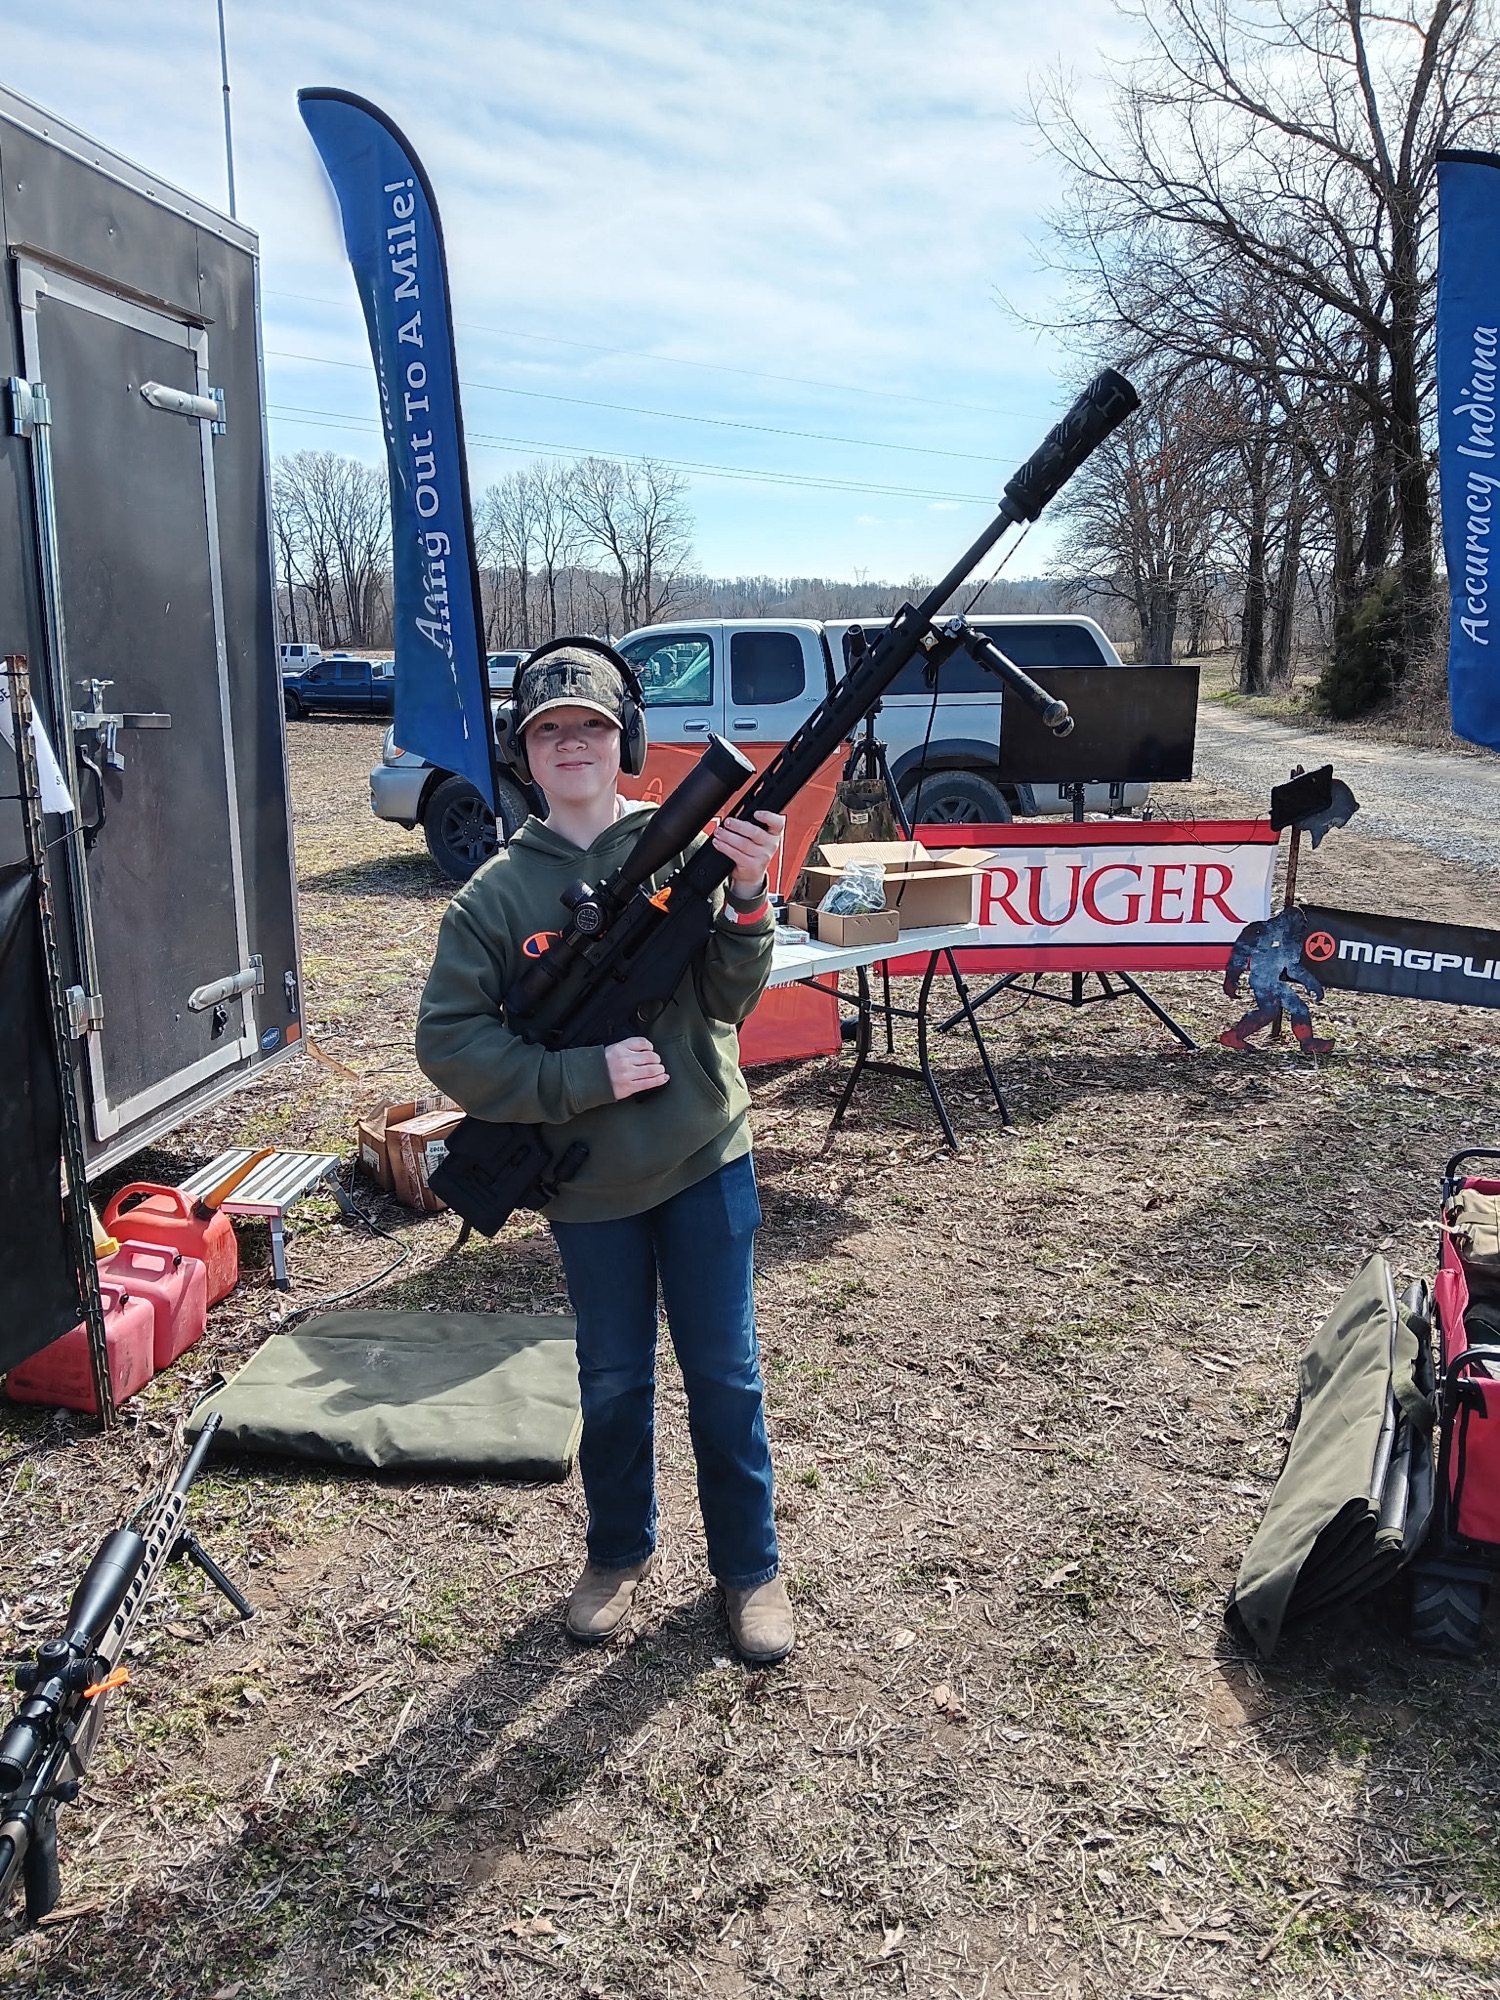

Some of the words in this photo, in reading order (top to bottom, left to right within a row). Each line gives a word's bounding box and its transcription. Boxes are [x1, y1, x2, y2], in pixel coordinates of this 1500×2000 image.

[384, 178, 420, 302] Mile!
[398, 310, 424, 349] A
[404, 361, 430, 422] To
[1452, 326, 1498, 458] Indiana
[410, 429, 439, 518] Out
[1460, 472, 1500, 646] Accuracy
[978, 863, 1249, 926] RUGER
